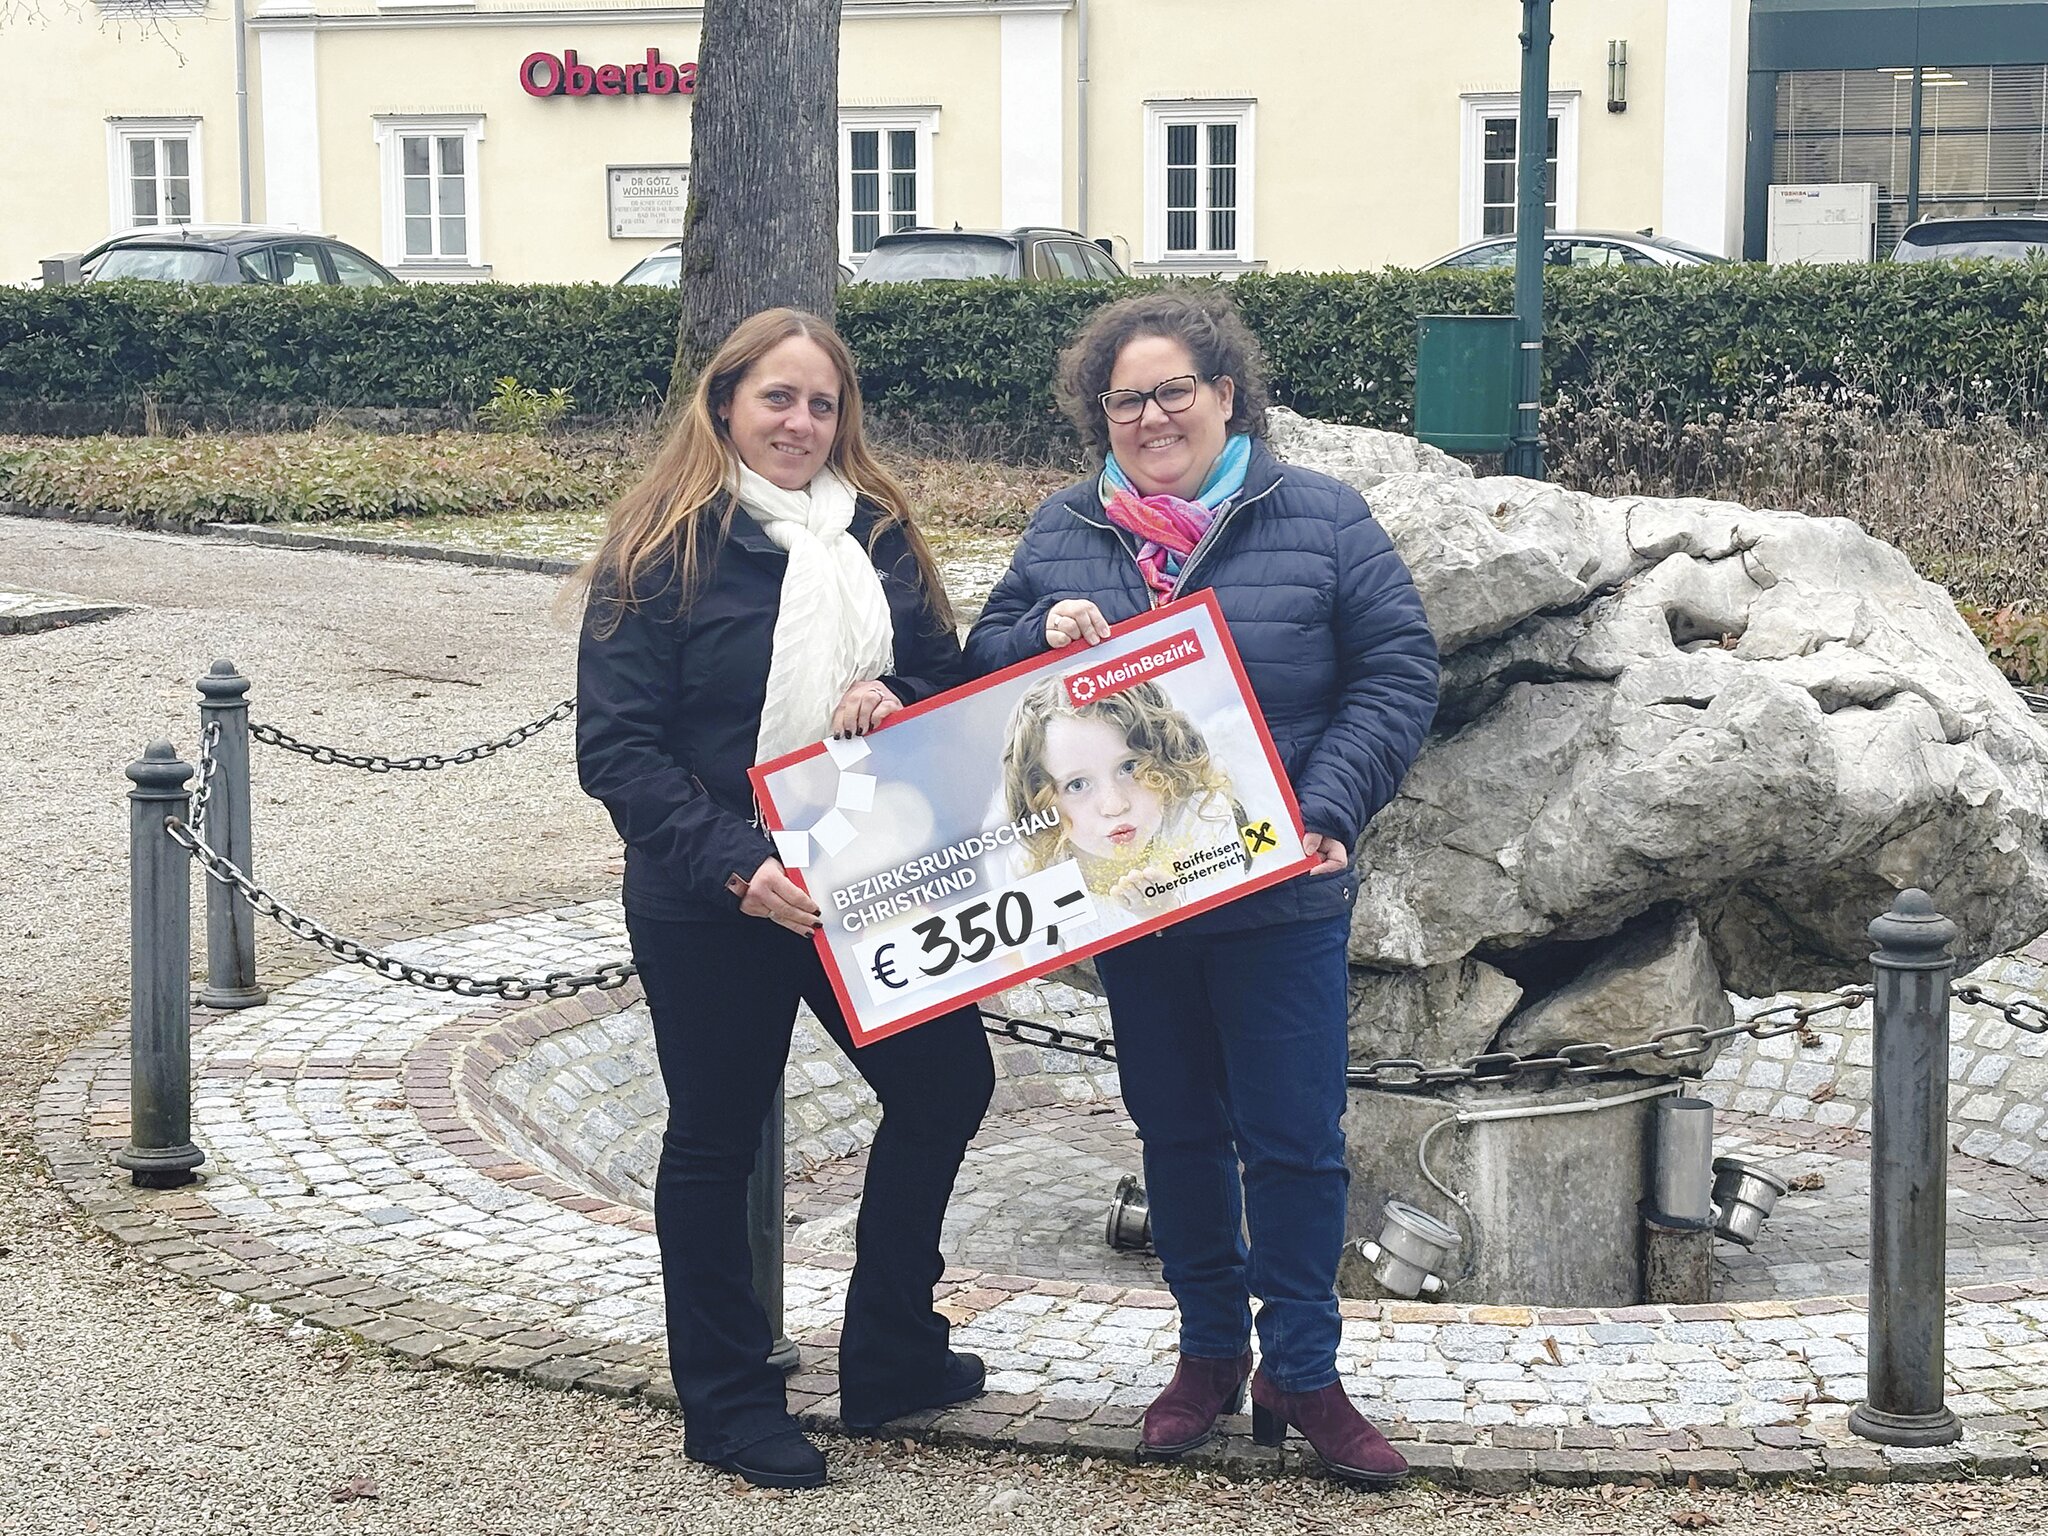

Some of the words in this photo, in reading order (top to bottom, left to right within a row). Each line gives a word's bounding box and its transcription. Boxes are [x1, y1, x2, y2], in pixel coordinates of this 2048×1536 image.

[622, 186, 679, 196] WOHNHAUS
[1096, 638, 1198, 690] MeinBezirk
[831, 805, 1061, 910] BEZIRKSRUNDSCHAU
[1144, 851, 1246, 899] Oberösterreich
[1172, 839, 1241, 874] Raiffeisen
[842, 867, 977, 933] CHRISTKIND
[871, 943, 909, 989] €
